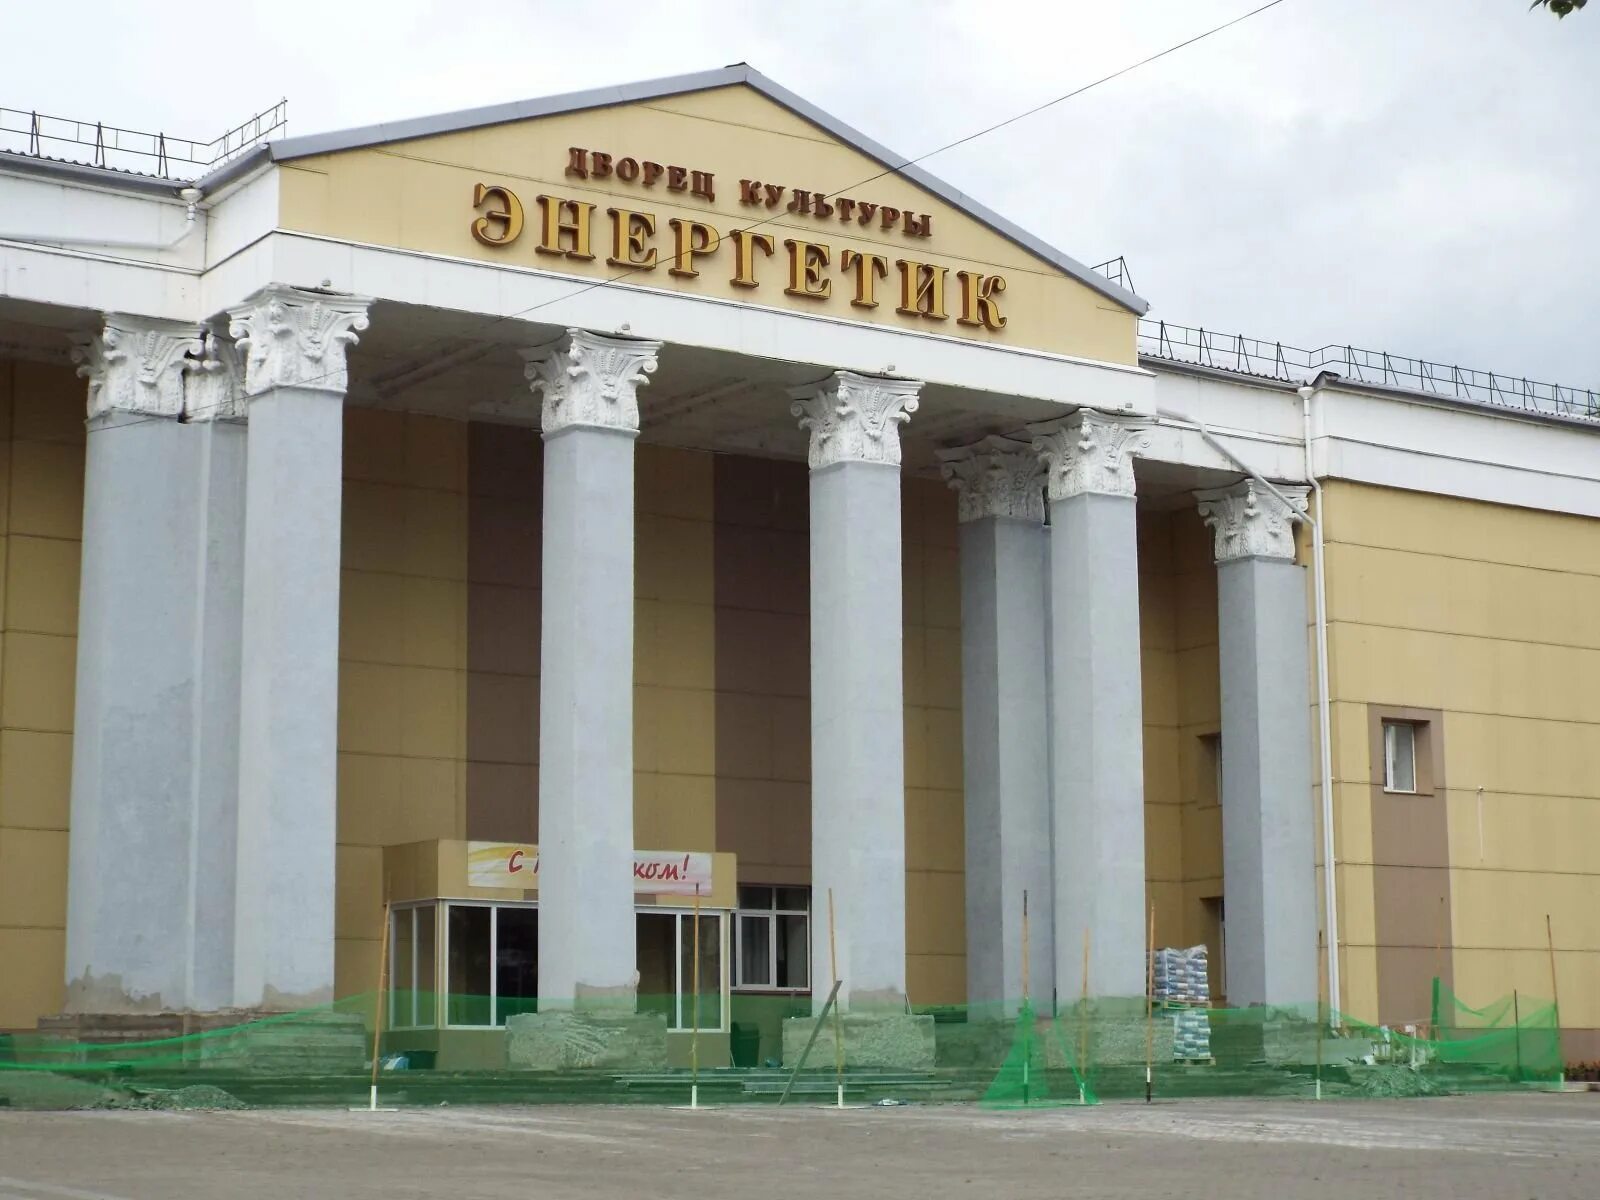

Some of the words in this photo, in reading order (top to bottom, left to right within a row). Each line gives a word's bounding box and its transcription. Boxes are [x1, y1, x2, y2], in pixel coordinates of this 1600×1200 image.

[565, 147, 716, 202] ДВОРЕЦ
[738, 179, 932, 237] КУЛЬТУРЫ
[471, 183, 1008, 331] ЭНЕРГЕТИК
